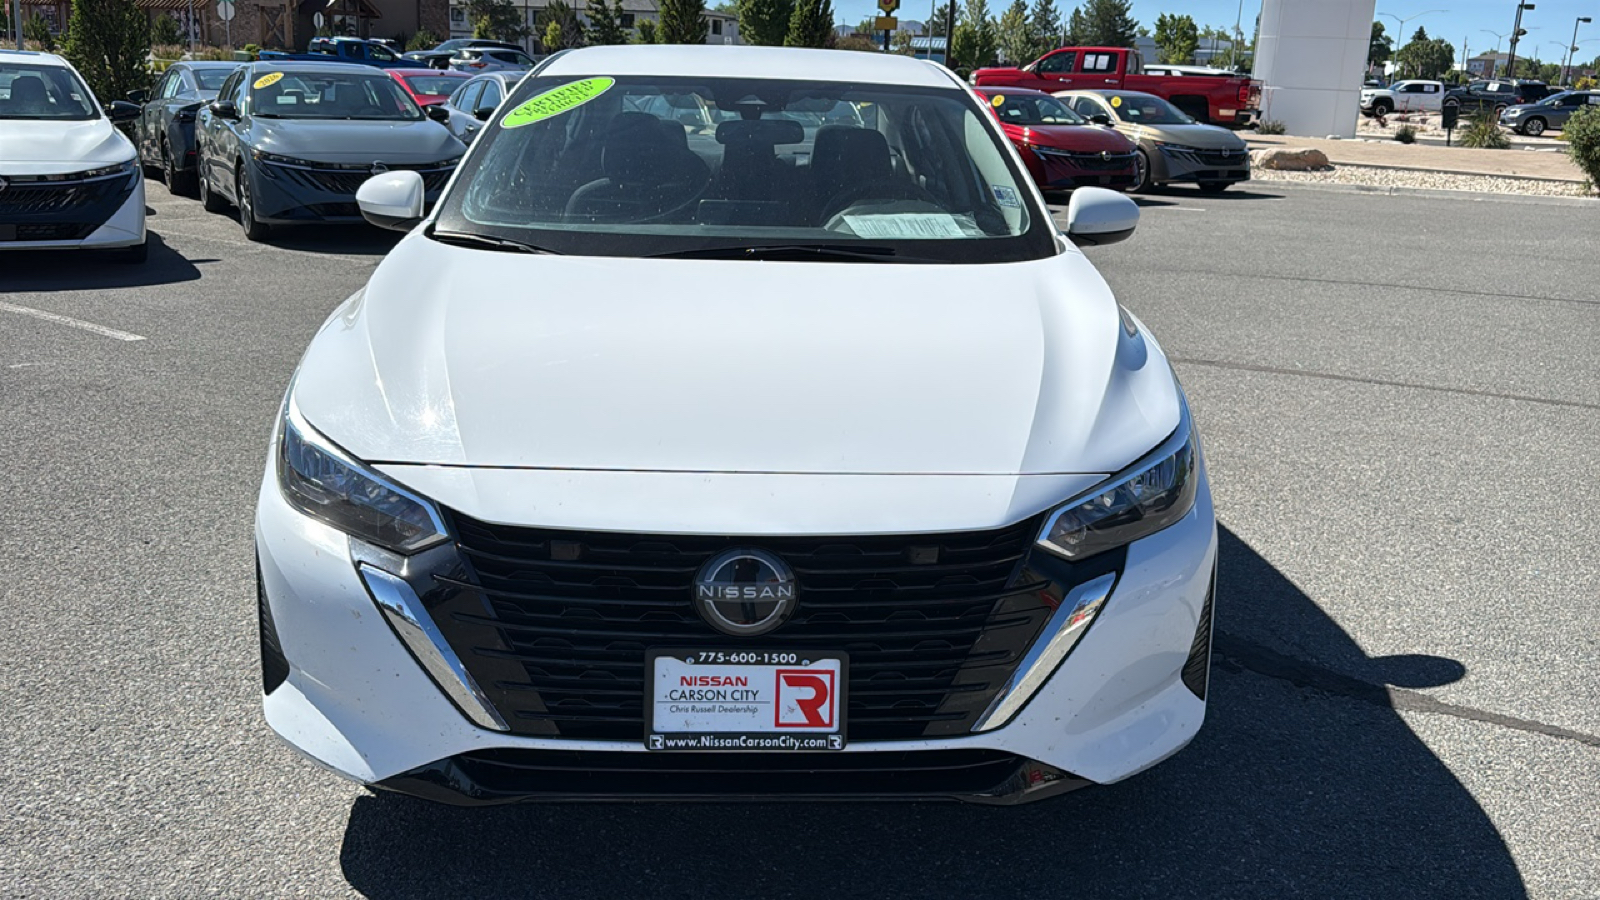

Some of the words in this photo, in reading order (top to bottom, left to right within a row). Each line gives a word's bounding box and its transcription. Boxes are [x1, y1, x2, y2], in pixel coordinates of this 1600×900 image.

[513, 80, 592, 116] CERTIFIED
[699, 585, 792, 599] NISSAN
[699, 652, 797, 664] 775-600-1500
[680, 675, 748, 687] NISSAN
[669, 689, 727, 701] CARSON
[730, 689, 760, 701] CITY
[669, 704, 690, 714] Chris
[691, 704, 716, 714] Russell
[718, 704, 758, 715] Dealership
[665, 735, 827, 750] www.NissanCarsonCity.com
